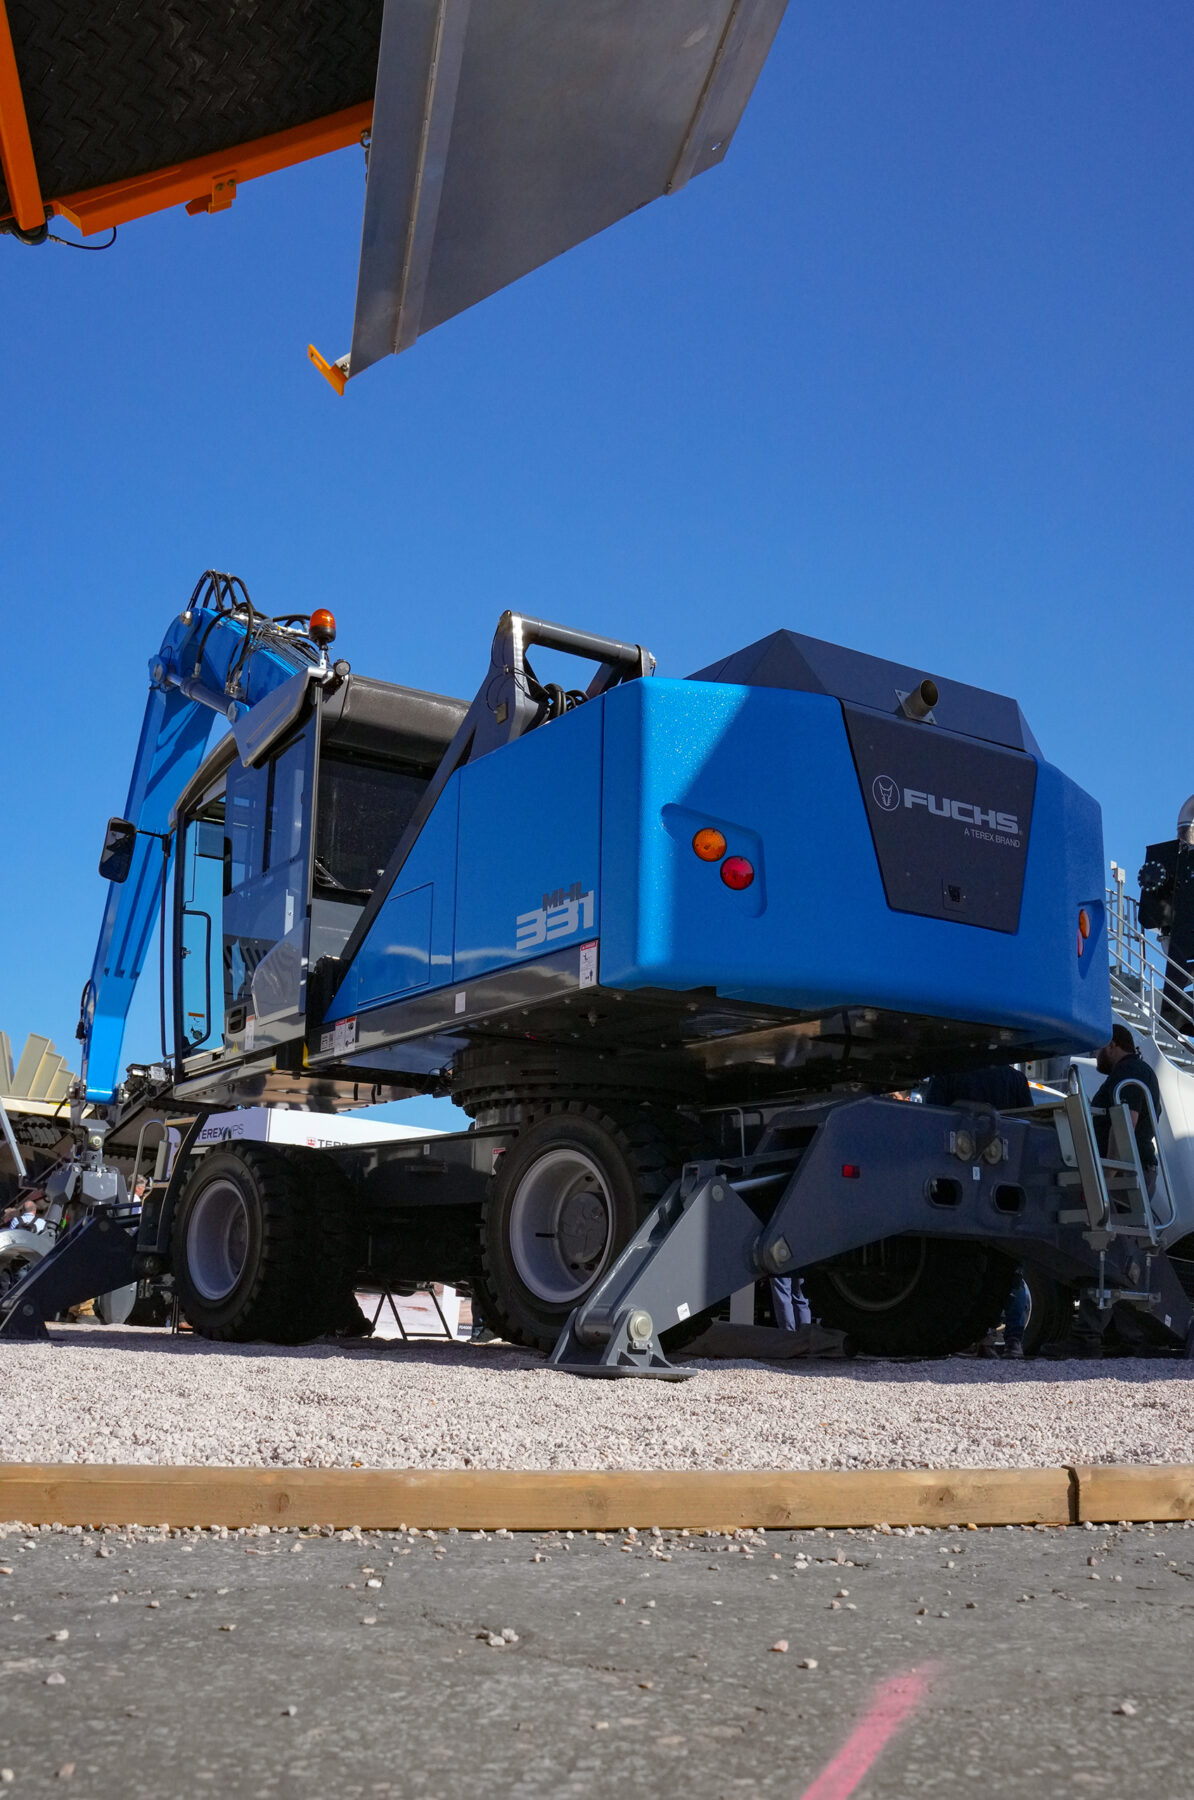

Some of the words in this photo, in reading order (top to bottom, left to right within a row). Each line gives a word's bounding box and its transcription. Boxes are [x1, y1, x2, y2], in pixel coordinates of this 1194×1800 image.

[903, 787, 1019, 835] FUCHS
[964, 827, 970, 836] A
[970, 828, 995, 842] TEREX
[995, 834, 1021, 848] BRAND
[542, 880, 589, 912] MHL
[516, 890, 595, 951] 331
